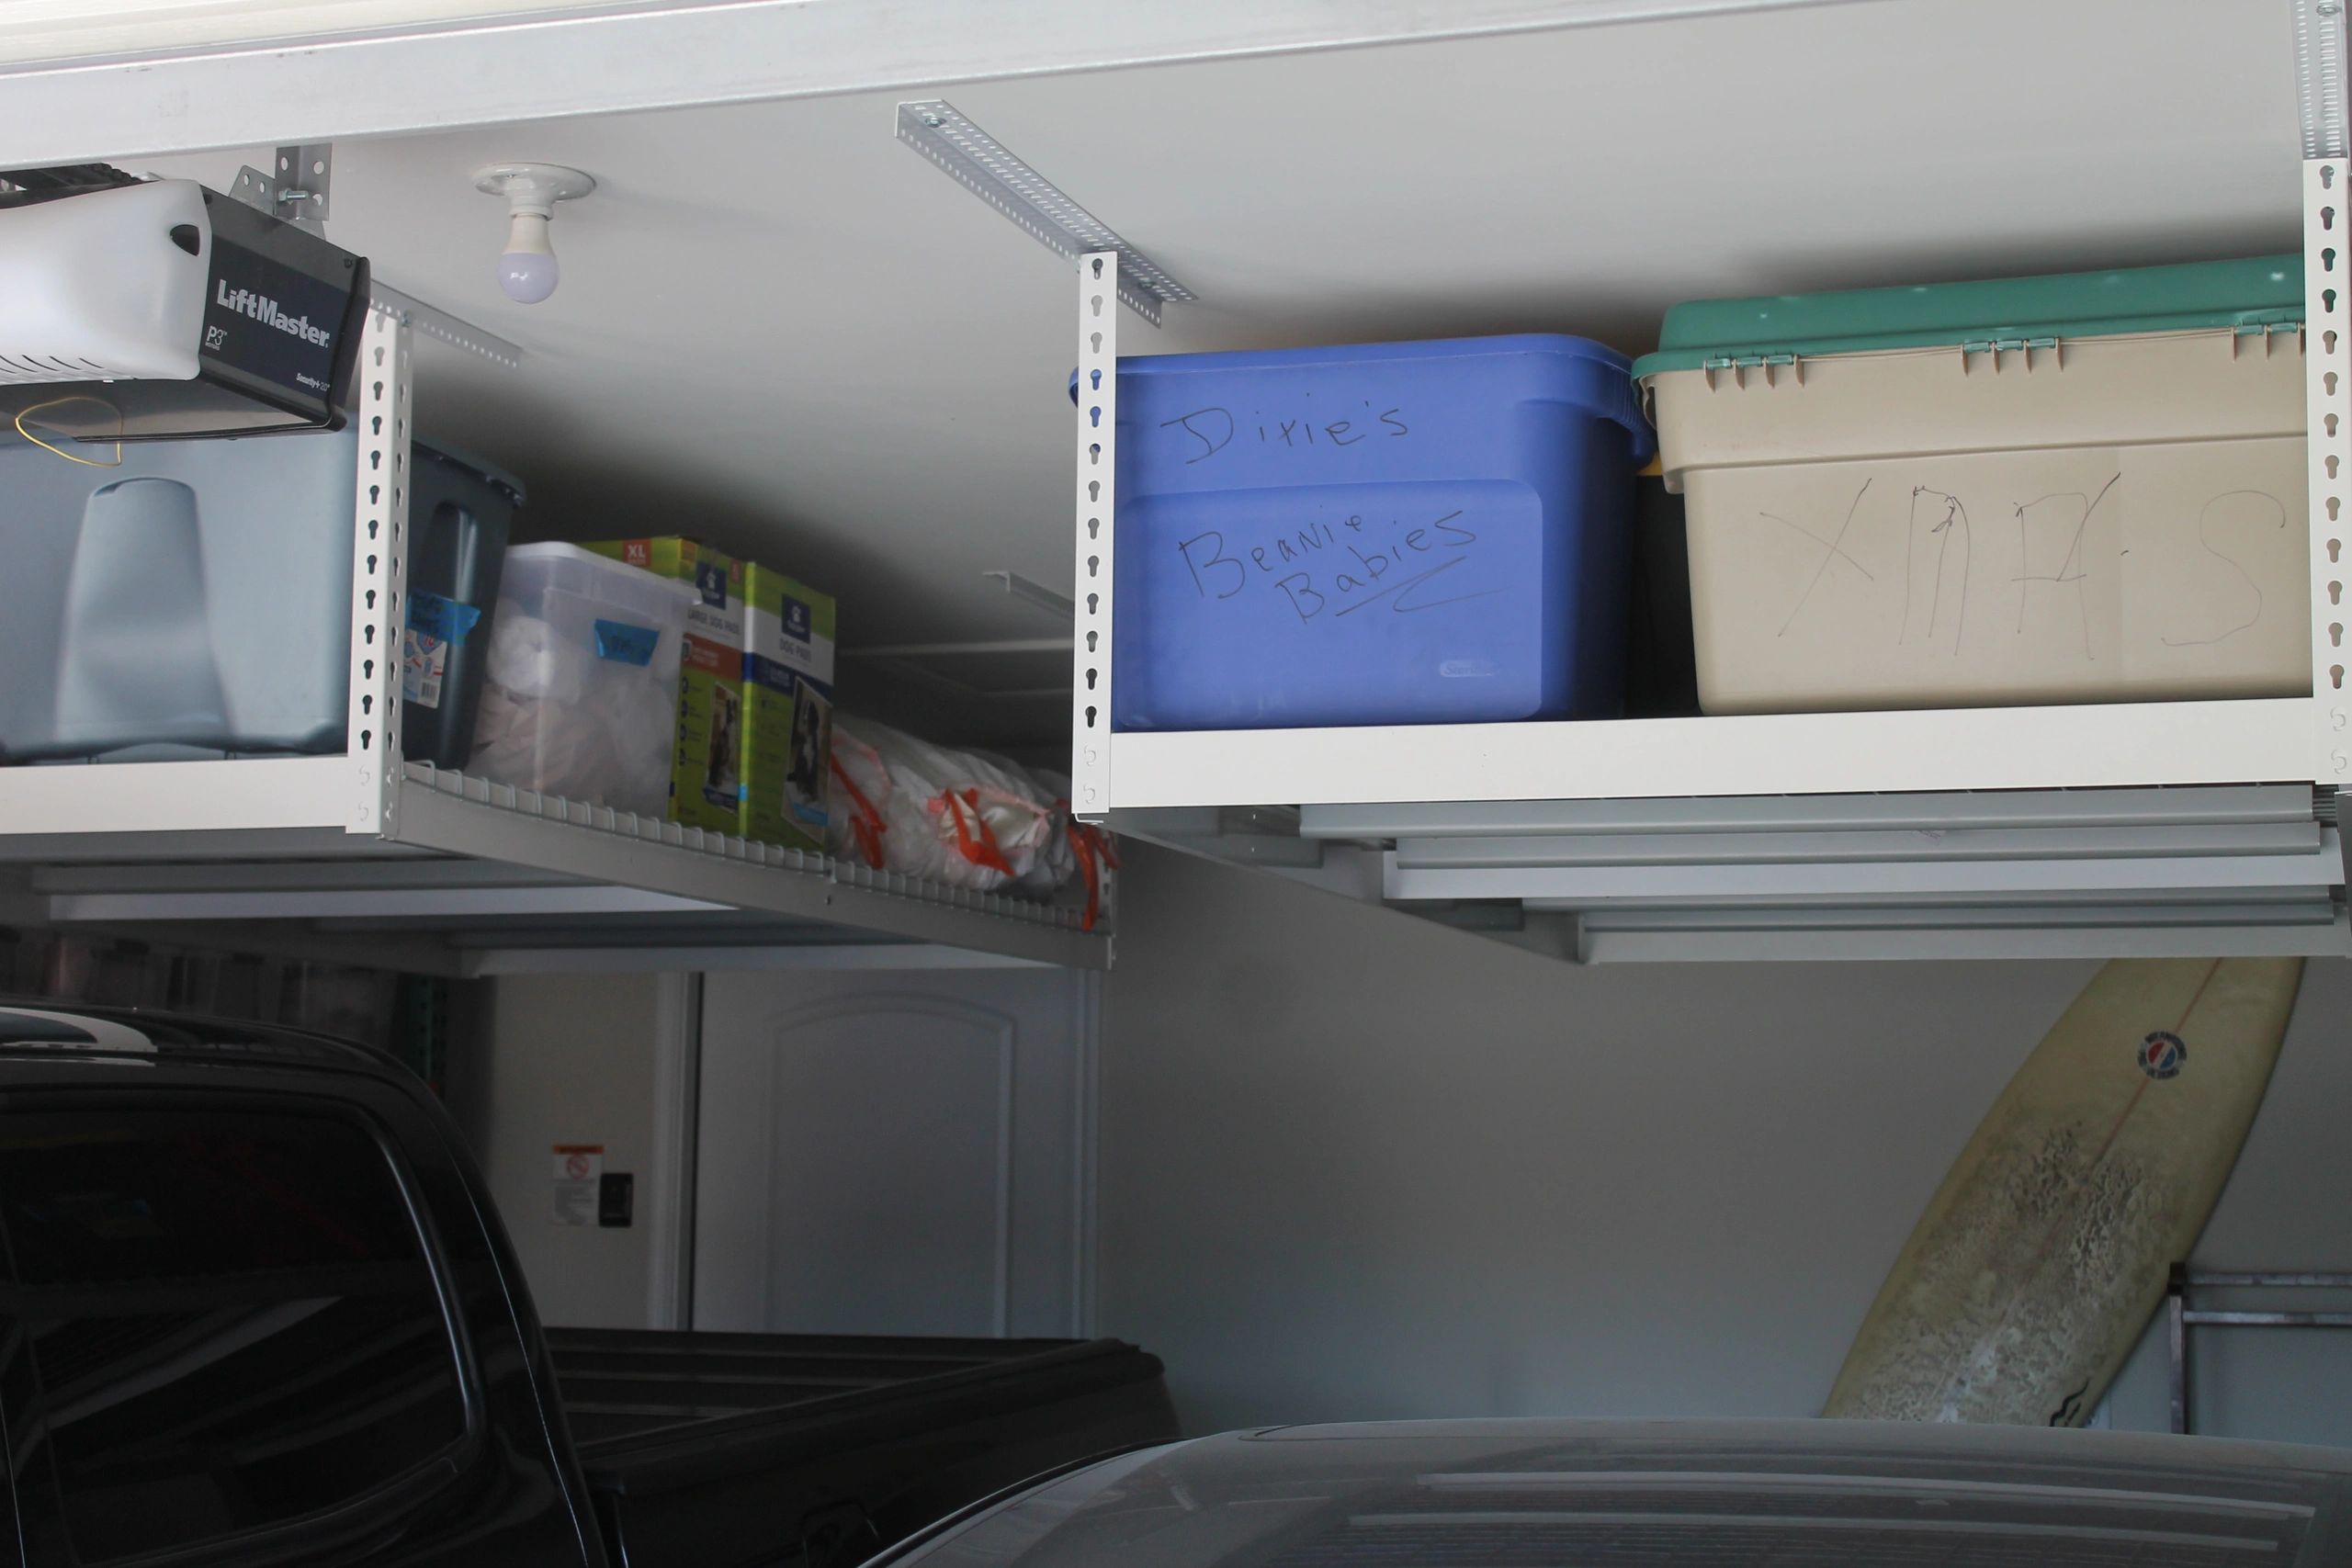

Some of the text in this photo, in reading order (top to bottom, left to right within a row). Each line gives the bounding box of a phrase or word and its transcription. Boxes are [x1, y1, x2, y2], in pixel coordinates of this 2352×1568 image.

[216, 278, 330, 348] LiftMaster
[1159, 392, 1408, 465] Dixie's
[627, 544, 646, 558] XL
